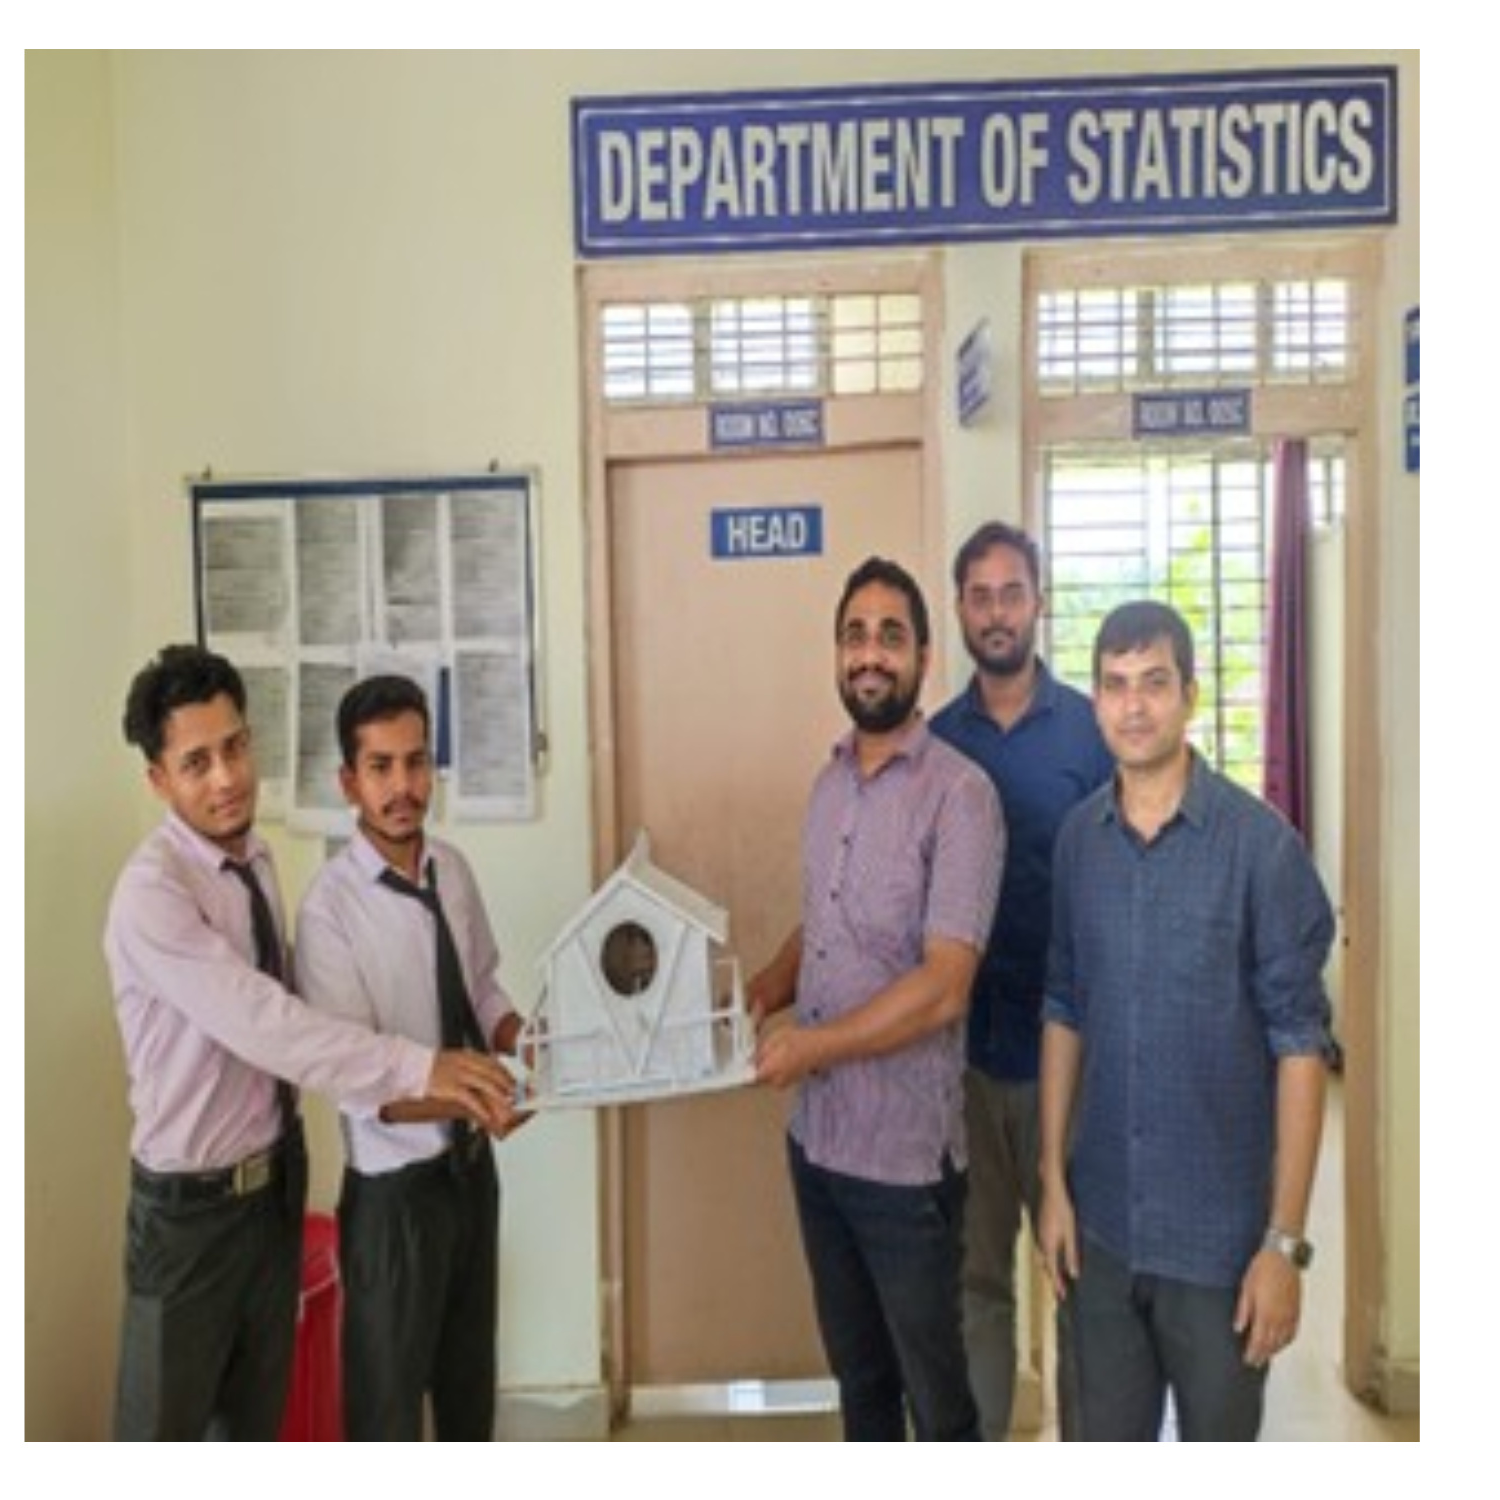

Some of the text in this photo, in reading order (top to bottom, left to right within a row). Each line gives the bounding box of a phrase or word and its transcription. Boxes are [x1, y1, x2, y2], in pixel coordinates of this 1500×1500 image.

[598, 98, 1374, 222] DEPARTMENT OF STATISTICS
[728, 511, 807, 554] HEAD
